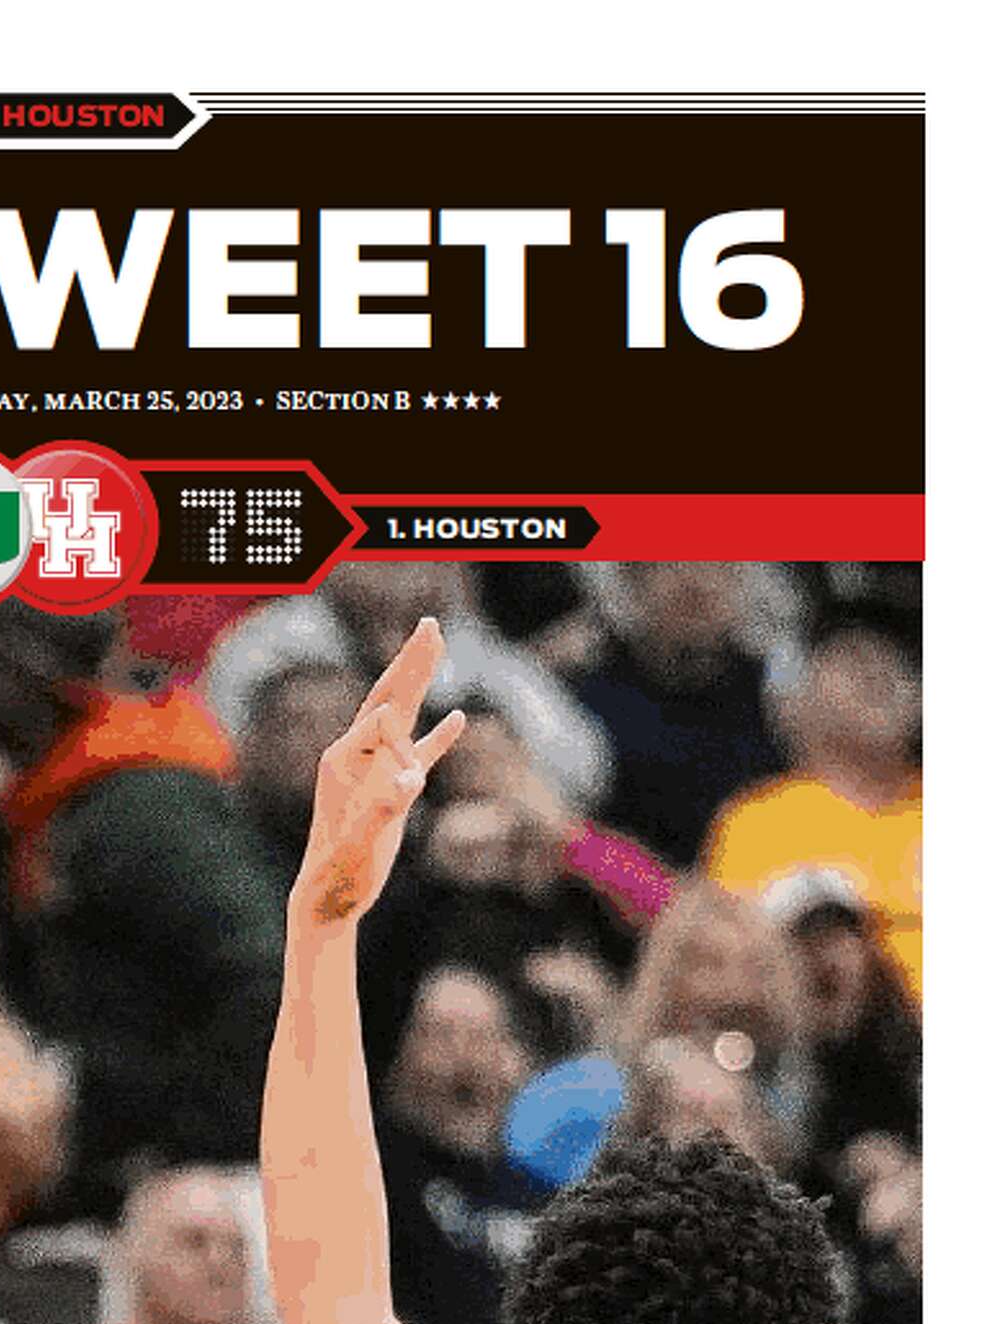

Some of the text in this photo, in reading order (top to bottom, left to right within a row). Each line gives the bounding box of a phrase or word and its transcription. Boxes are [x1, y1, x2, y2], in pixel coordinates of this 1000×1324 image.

[4, 105, 163, 127] HOUSTON
[606, 207, 804, 350] 16
[45, 391, 140, 412] MARCH
[147, 391, 180, 412] 25,
[186, 391, 243, 412] 2023
[277, 391, 411, 411] SECTION B
[181, 489, 302, 564] 75
[388, 518, 566, 539] 1. HOUSTON
